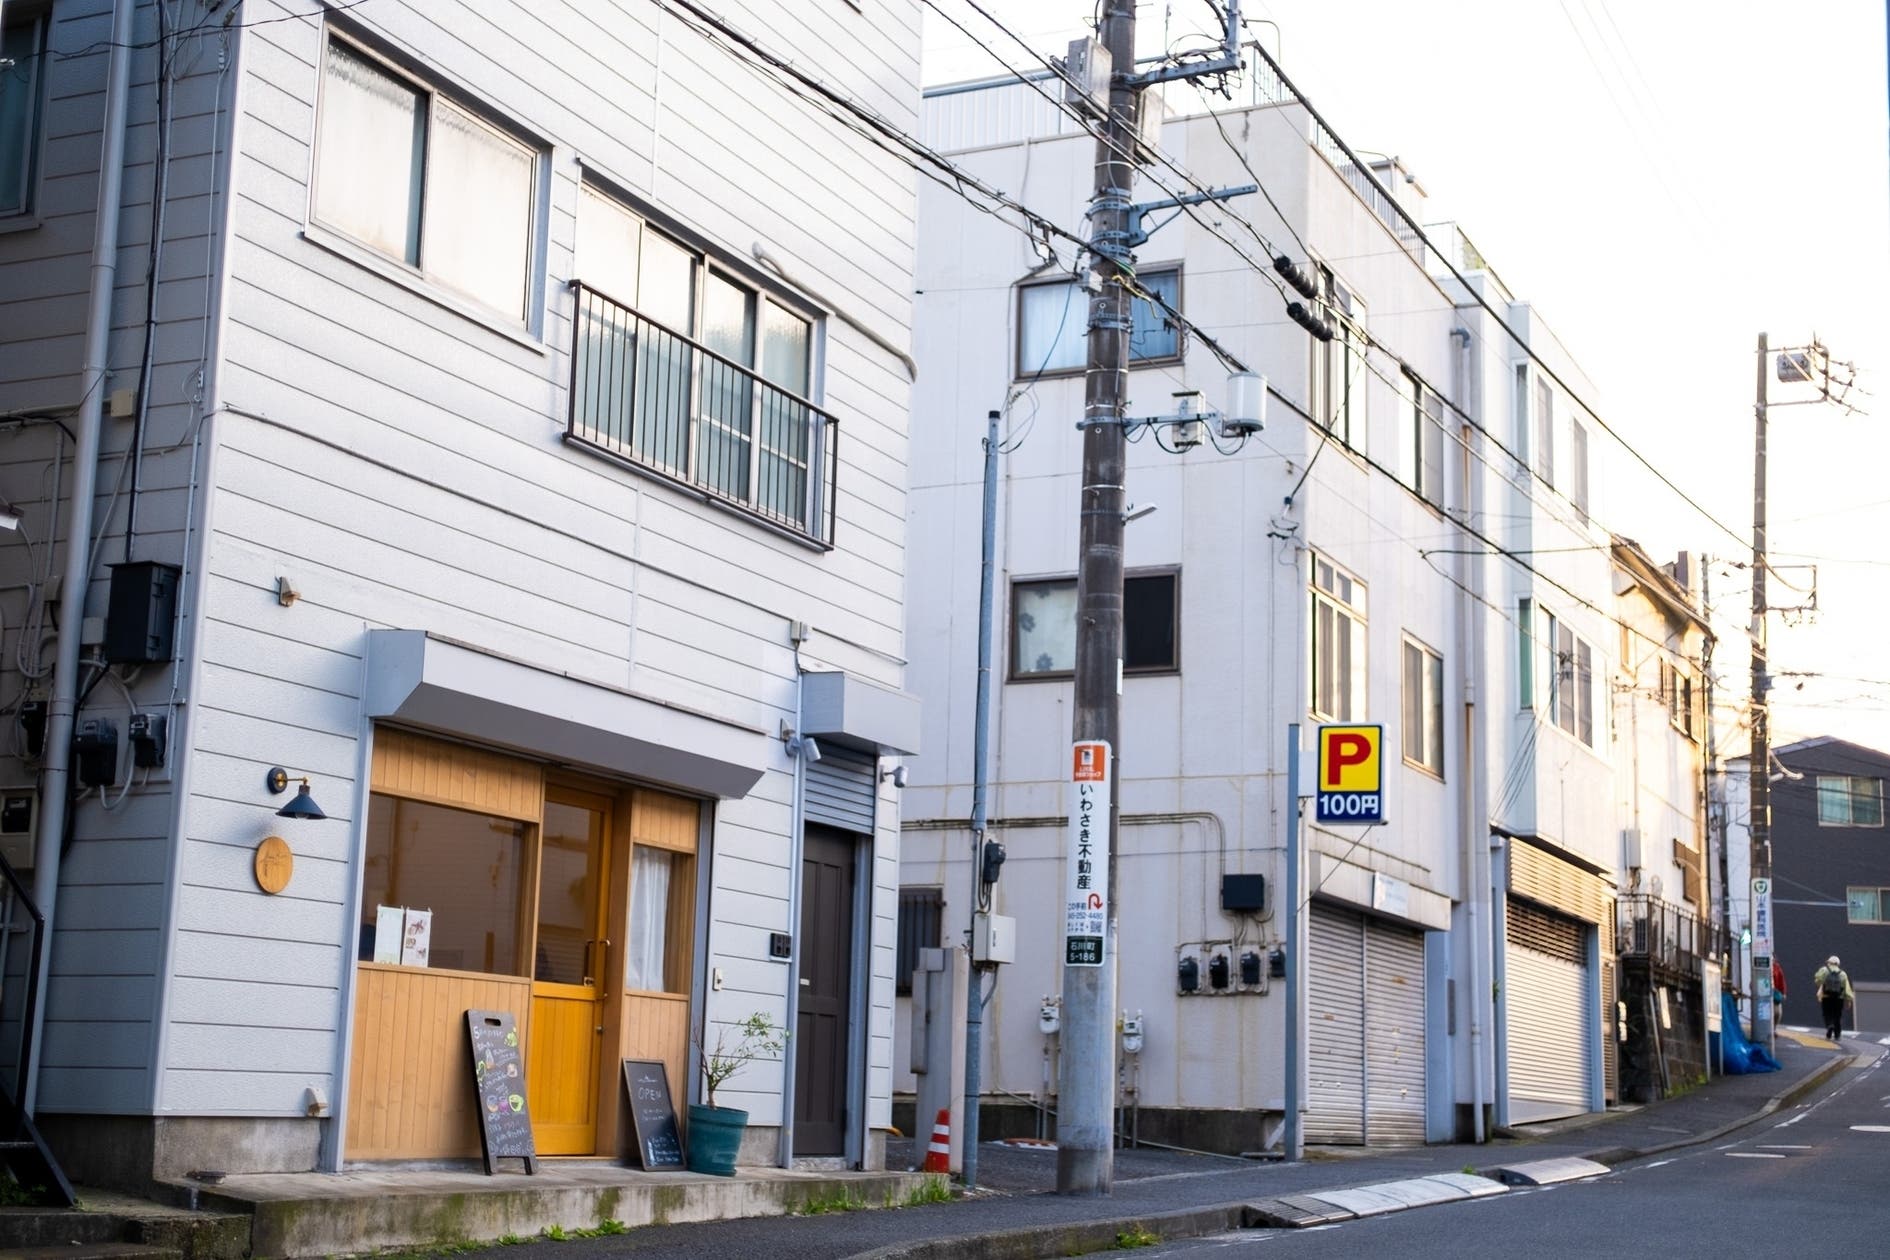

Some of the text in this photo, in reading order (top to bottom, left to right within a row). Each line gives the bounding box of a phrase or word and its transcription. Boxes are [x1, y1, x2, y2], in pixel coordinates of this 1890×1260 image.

[1328, 733, 1372, 786] P
[1320, 794, 1379, 815] 100円
[1077, 783, 1094, 890] いわさき不動産
[1071, 941, 1095, 951] 石川町
[1070, 952, 1095, 961] 5-186
[638, 1087, 662, 1101] OPEN
